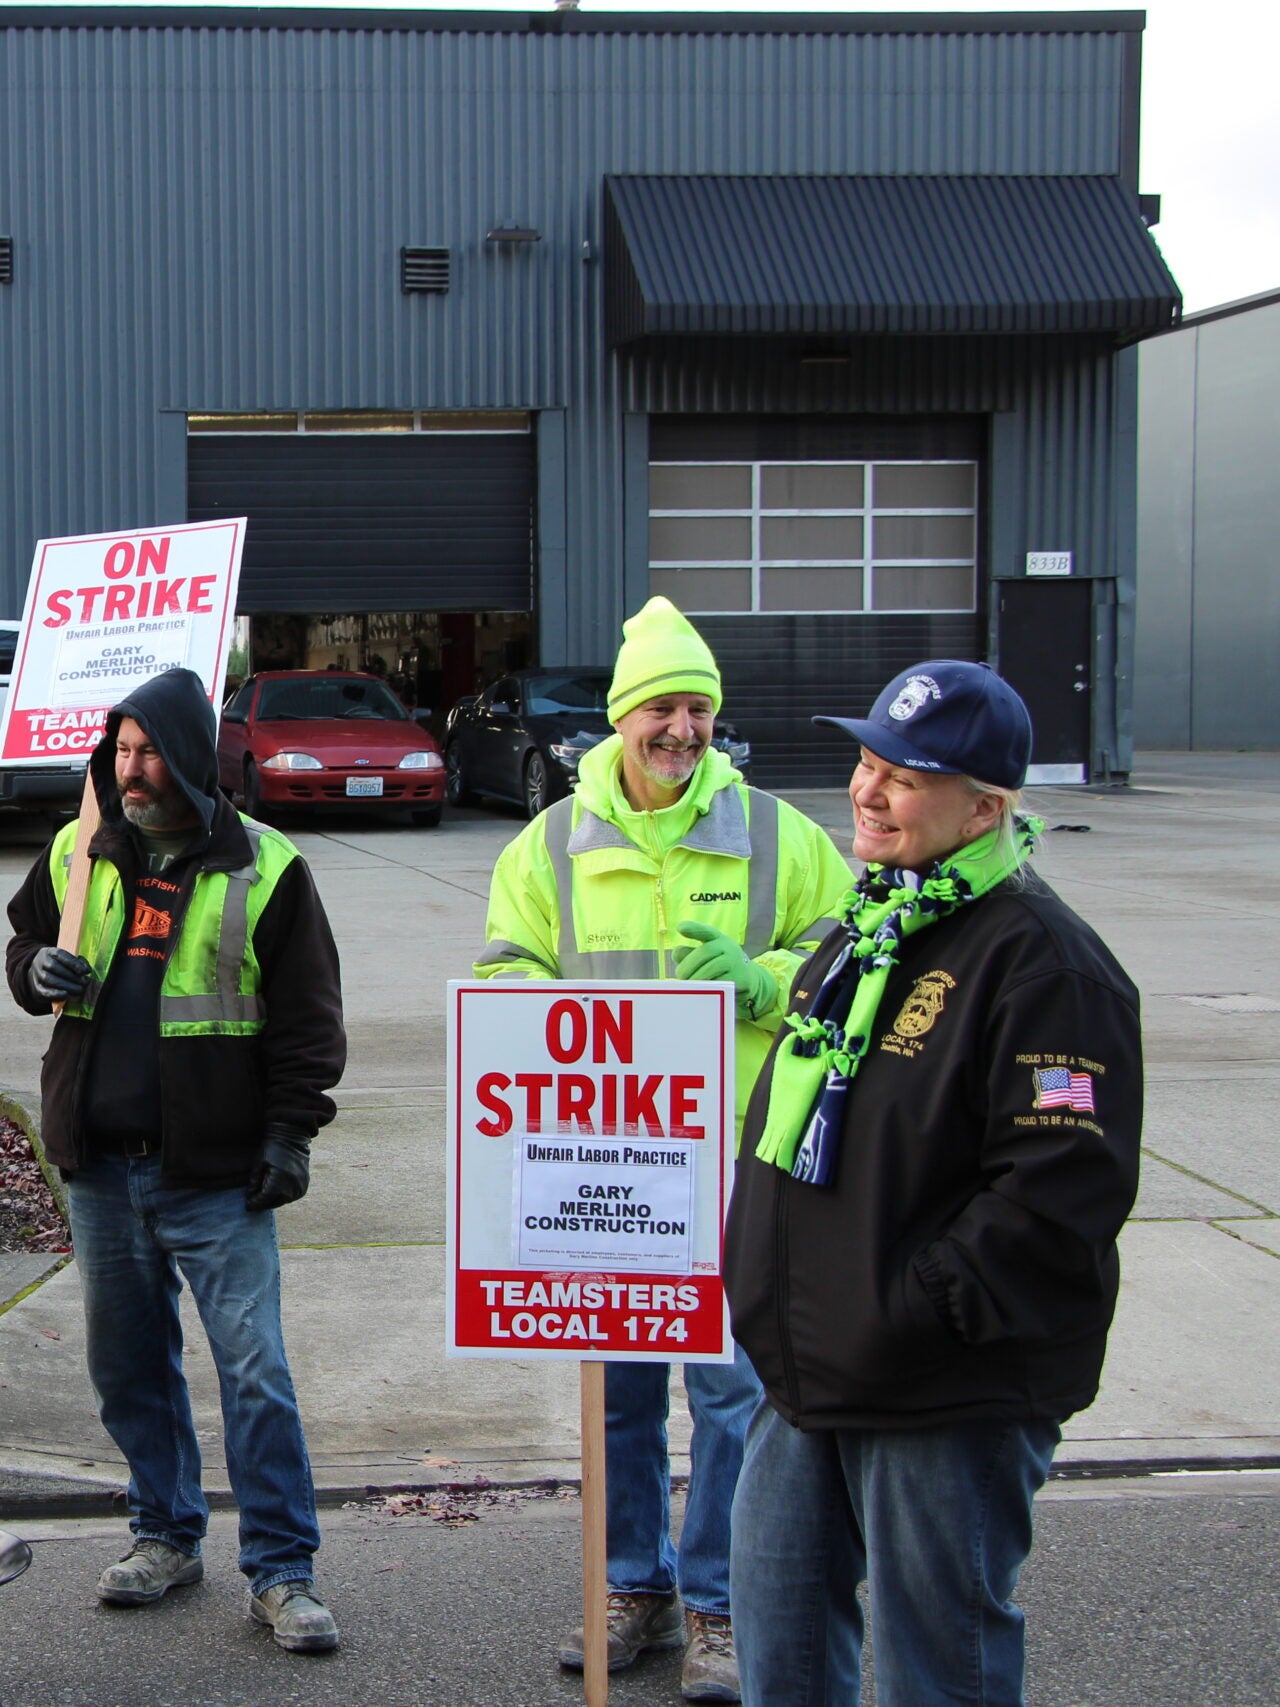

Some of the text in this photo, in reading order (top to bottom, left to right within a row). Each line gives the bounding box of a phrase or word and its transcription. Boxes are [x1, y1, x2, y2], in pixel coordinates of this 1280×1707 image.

[103, 537, 171, 579] ON
[43, 575, 217, 628] STRIKE
[65, 619, 185, 641] UNFAIR LABOR PRACTICE
[86, 654, 156, 669] MERLINO
[101, 645, 143, 658] GARY
[59, 661, 181, 681] CONSTRUCTION
[30, 730, 103, 751] LOCA
[690, 892, 742, 902] CADMAN
[587, 933, 621, 944] Steve
[128, 947, 166, 960] WASHIN
[545, 998, 633, 1064] ON
[881, 1034, 924, 1051] LOCAL 174
[1016, 1054, 1105, 1075] PROUD TO BE A TEAMSTER
[475, 1072, 705, 1139] STRIKE
[1014, 1116, 1037, 1126] PROUD
[1039, 1116, 1048, 1125] TO
[1051, 1116, 1061, 1125] BE
[1064, 1117, 1075, 1126] AN
[527, 1144, 687, 1166] UNFAIR LABOR PRACTICE
[578, 1185, 634, 1199] GARY
[559, 1202, 651, 1218] MERLINO
[524, 1216, 685, 1235] CONSTRUCTION
[480, 1281, 700, 1311] TEAMSTERS
[490, 1312, 688, 1342] LOCAL 174
